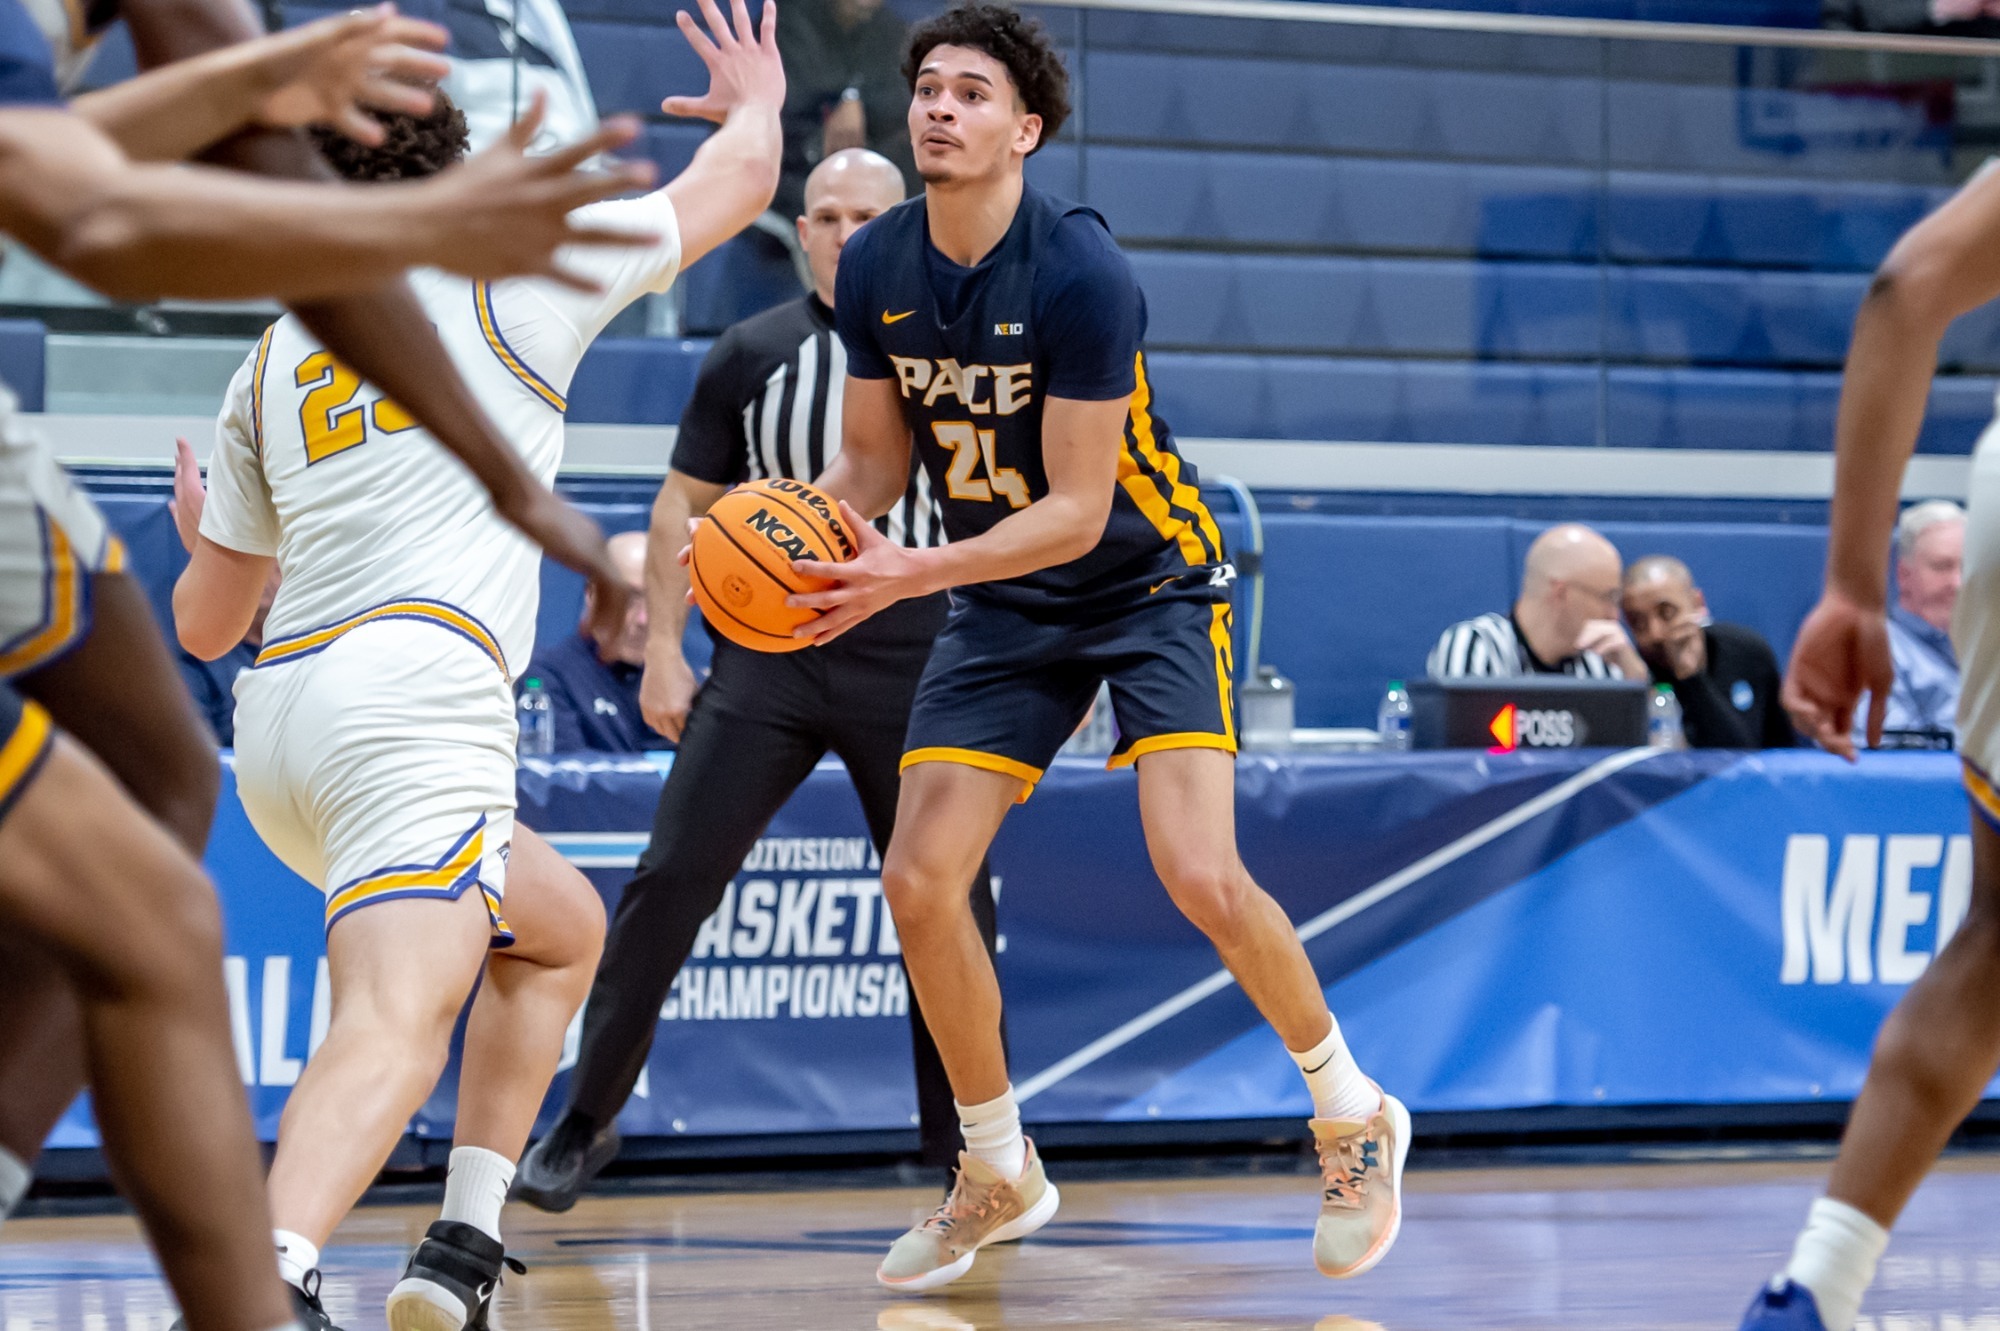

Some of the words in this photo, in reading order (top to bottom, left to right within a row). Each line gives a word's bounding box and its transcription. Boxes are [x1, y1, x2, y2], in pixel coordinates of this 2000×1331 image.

[887, 354, 1033, 416] PACE
[931, 420, 1033, 509] 24
[1513, 708, 1575, 747] POSS
[741, 837, 867, 872] DIVISION
[691, 877, 902, 959] ASKET
[659, 963, 910, 1021] CHAMPIONSH
